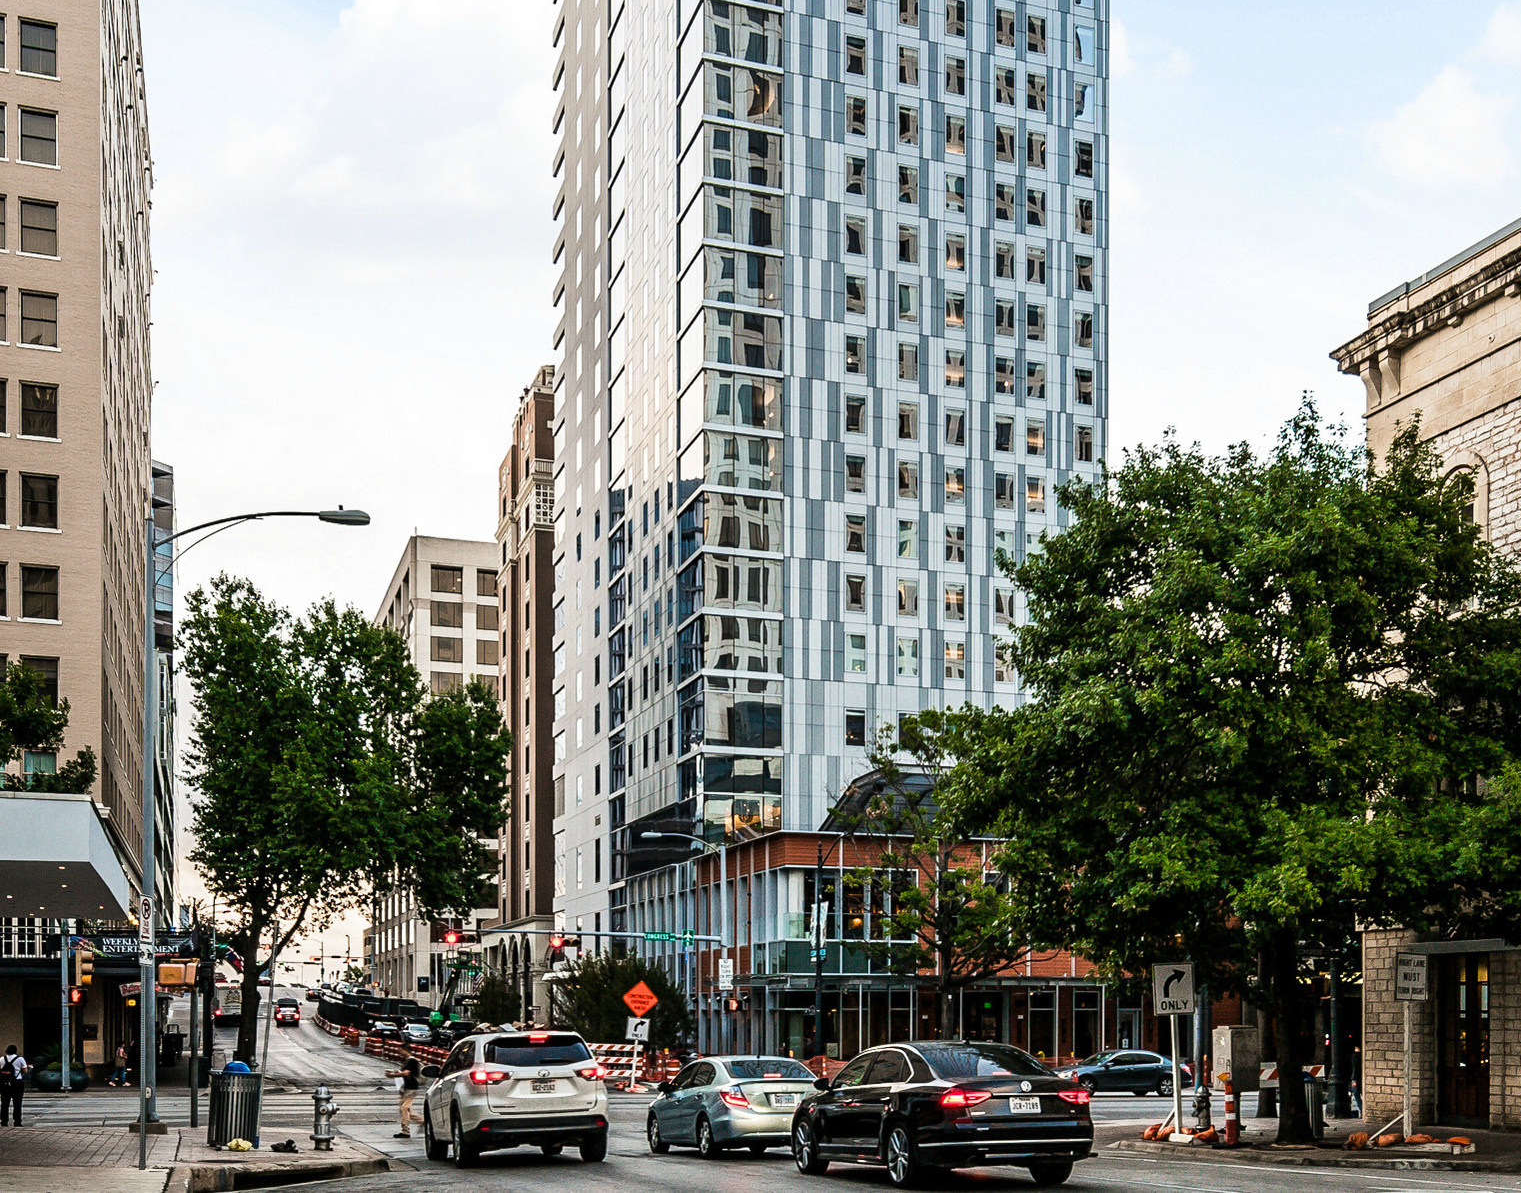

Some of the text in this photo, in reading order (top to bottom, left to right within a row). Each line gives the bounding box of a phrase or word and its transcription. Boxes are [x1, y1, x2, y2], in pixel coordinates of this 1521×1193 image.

[102, 938, 140, 946] WEEKLY
[1413, 959, 1426, 967] LANE
[1403, 972, 1420, 981] MUST
[1160, 999, 1189, 1011] ONLY
